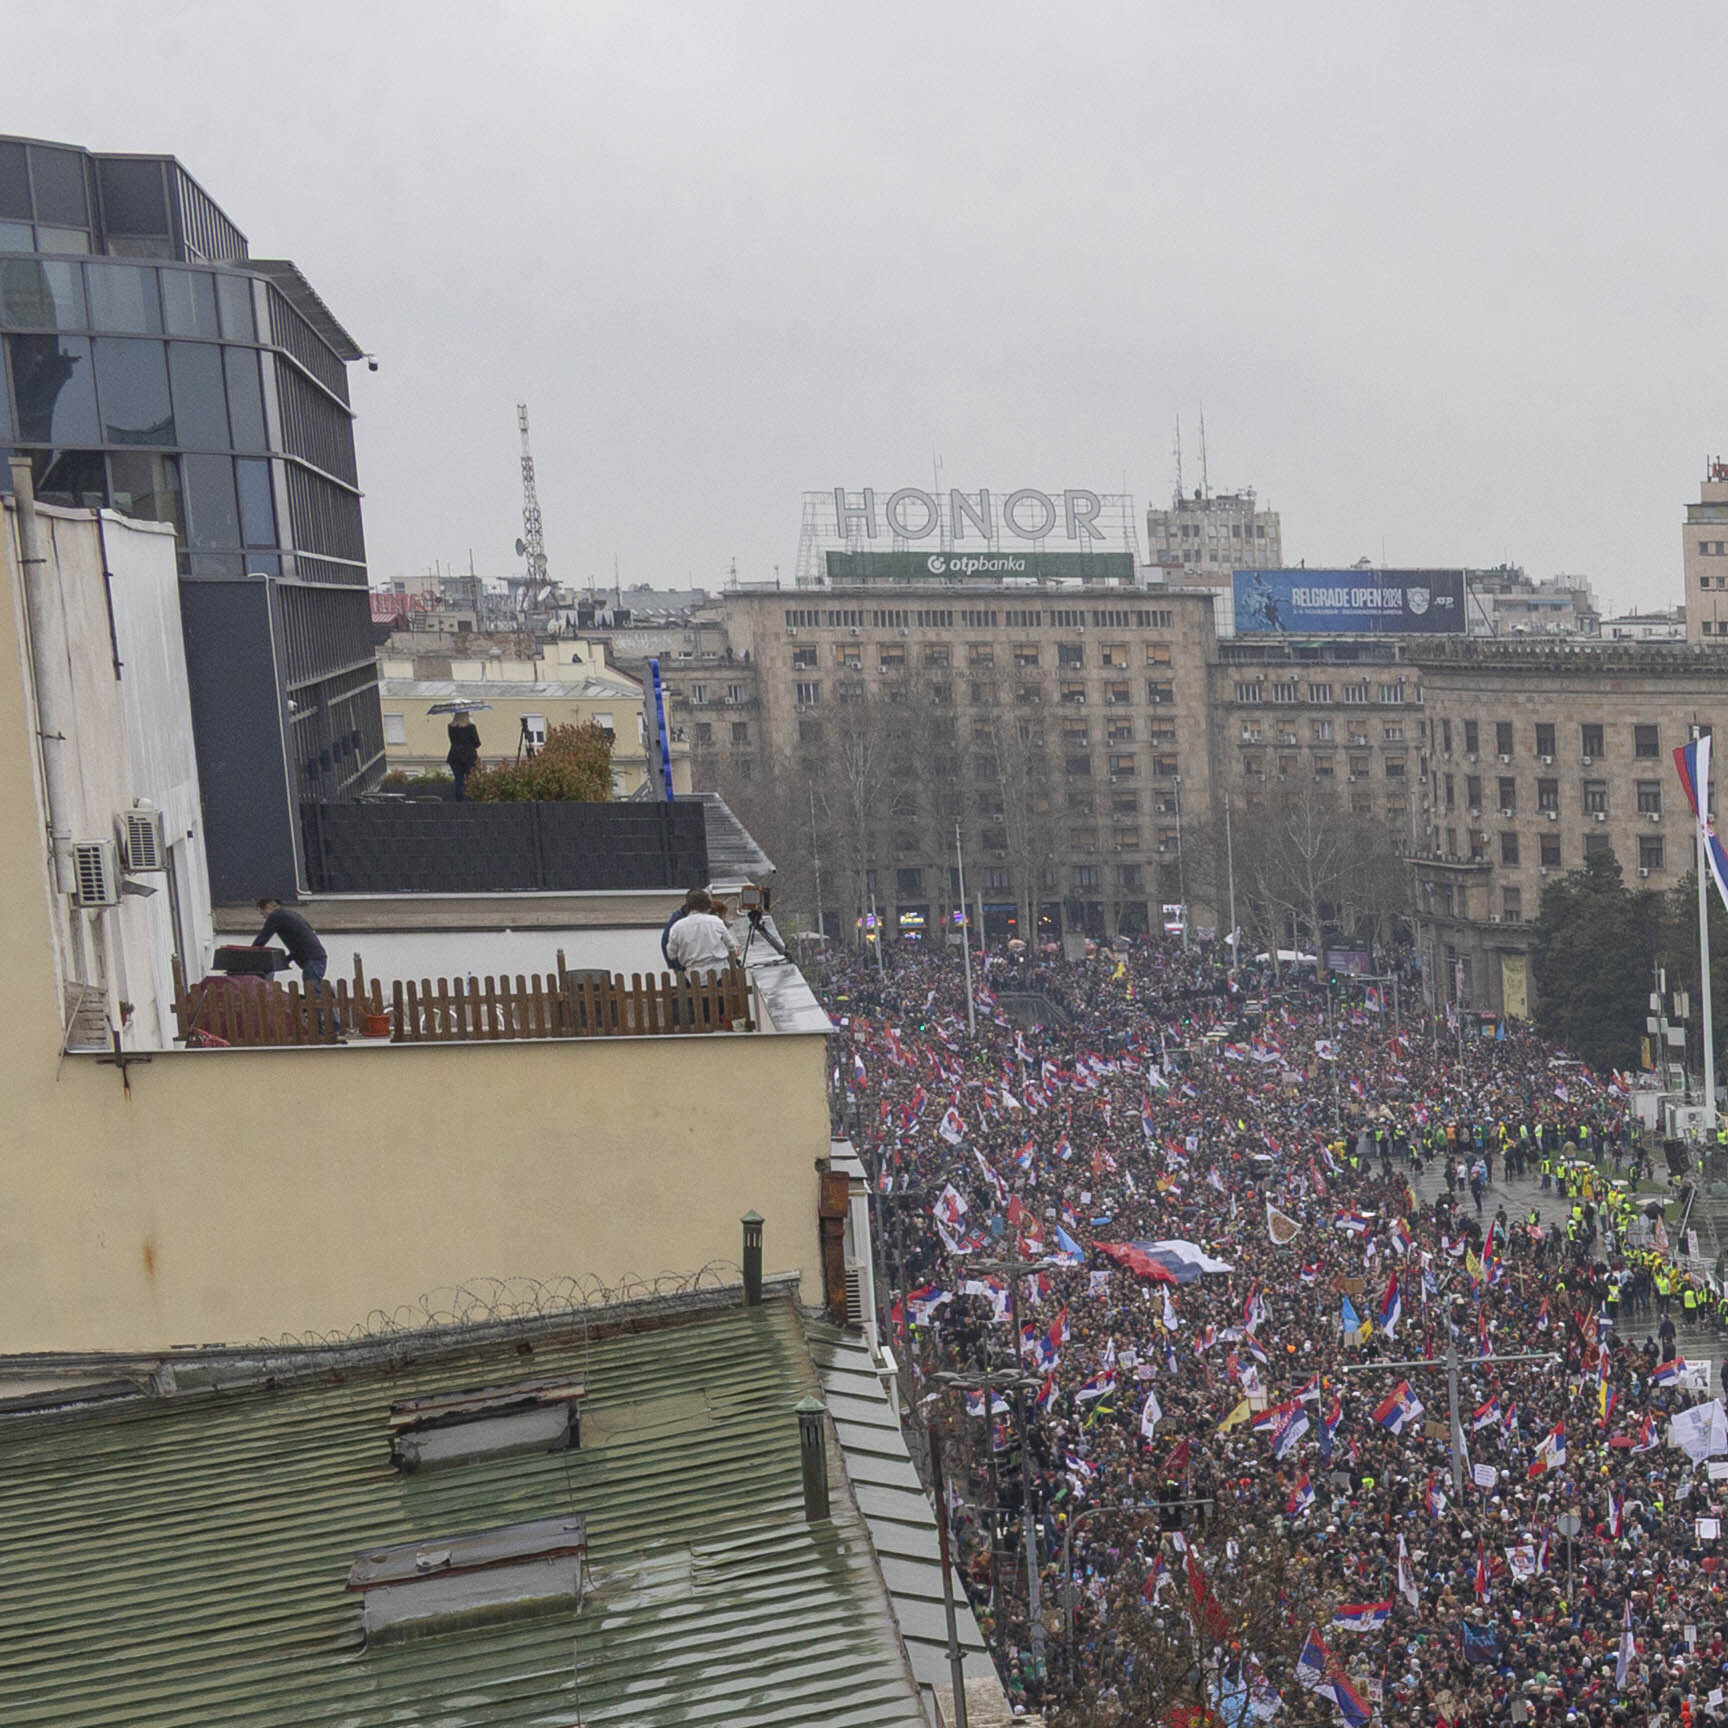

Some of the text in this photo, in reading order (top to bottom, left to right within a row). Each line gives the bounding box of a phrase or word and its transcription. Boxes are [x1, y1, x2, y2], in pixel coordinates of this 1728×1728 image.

[834, 487, 1106, 540] HONOR
[950, 555, 1025, 576] otpbanka
[1292, 587, 1402, 608] BELGRADE OPEN 2024
